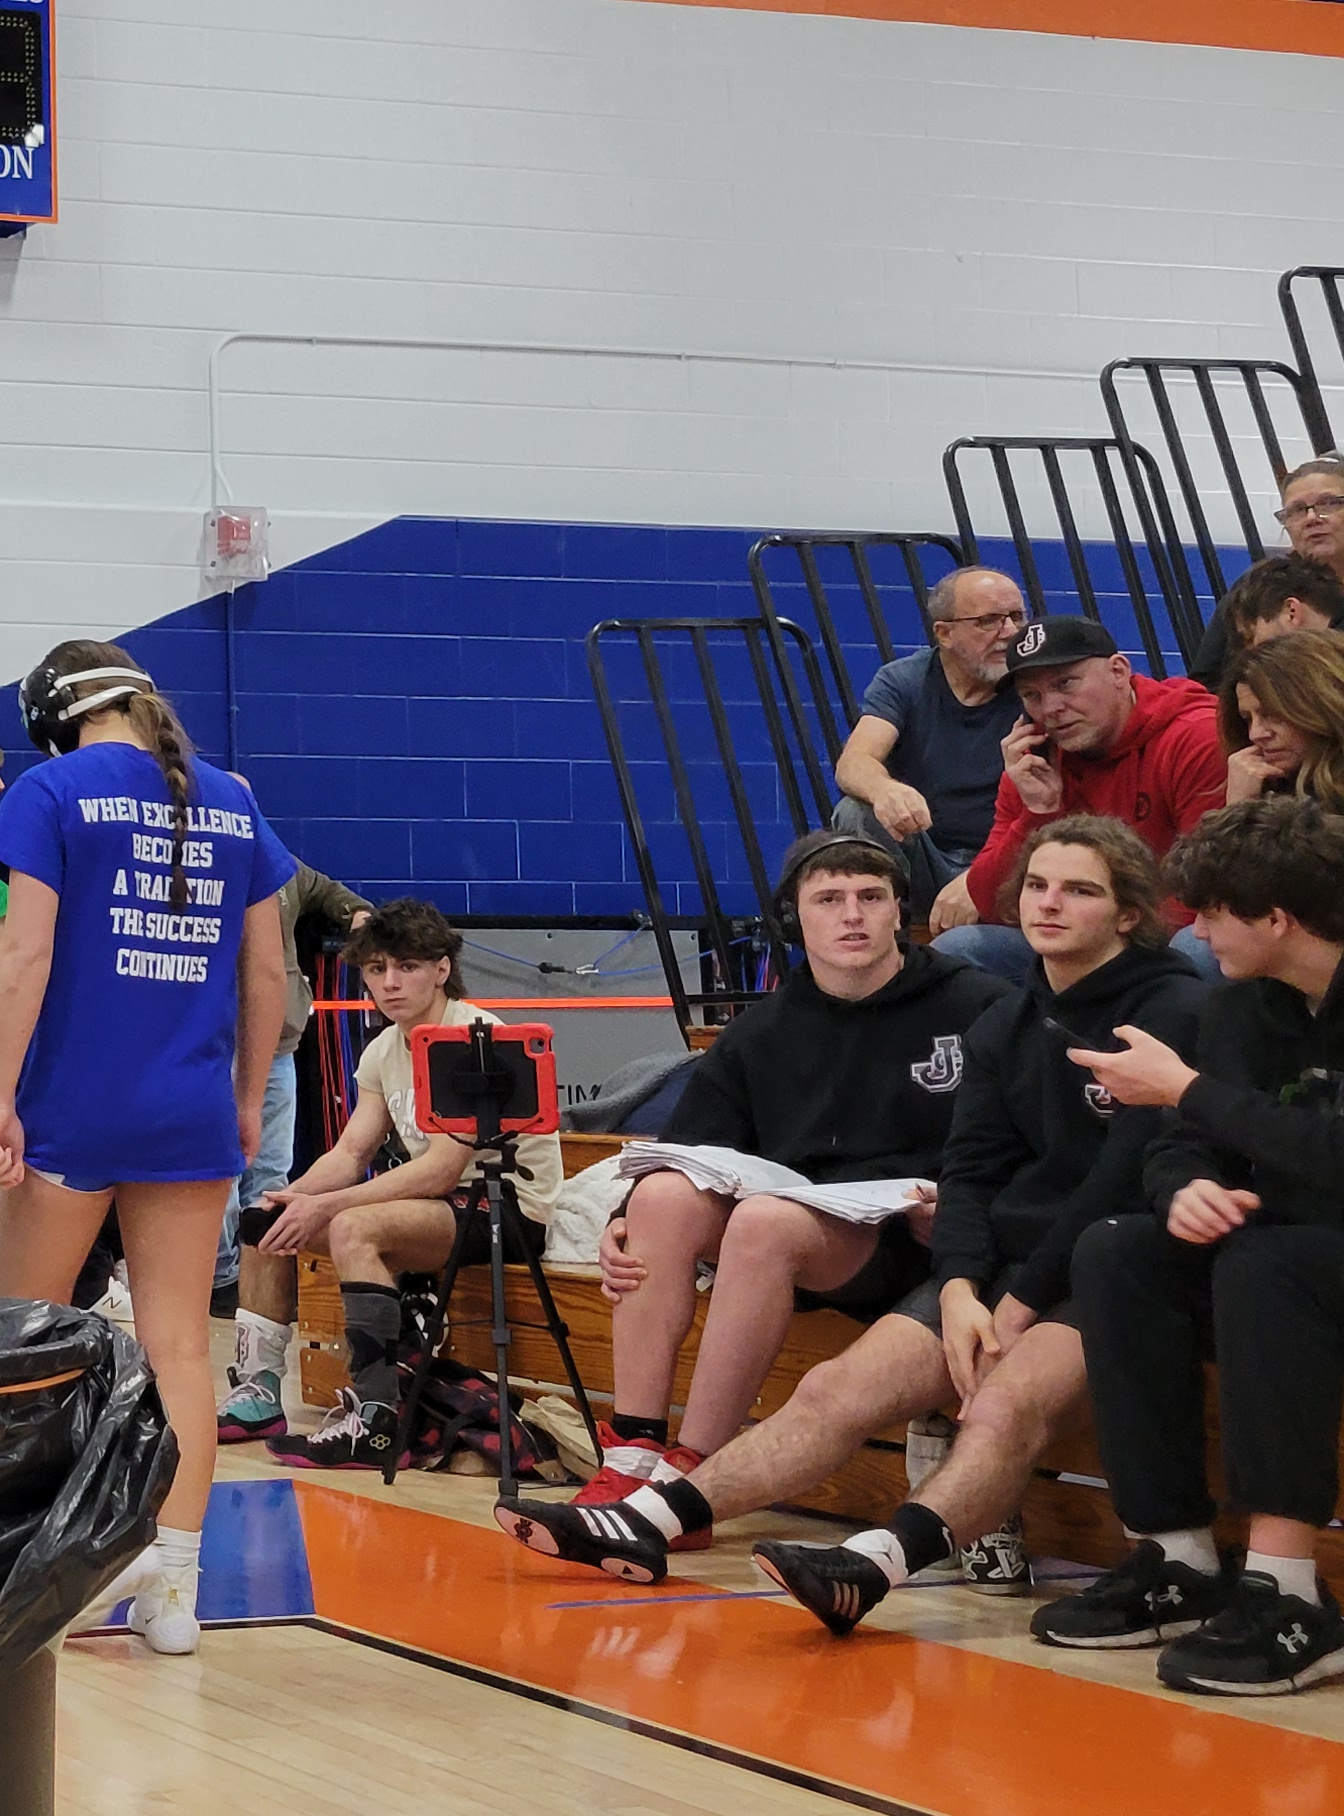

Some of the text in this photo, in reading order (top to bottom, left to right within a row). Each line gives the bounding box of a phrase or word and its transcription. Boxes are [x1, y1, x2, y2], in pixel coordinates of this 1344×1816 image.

[78, 796, 255, 840] WHEN EXCLLENCE
[113, 868, 129, 896] A
[145, 912, 223, 944] SUCCESS
